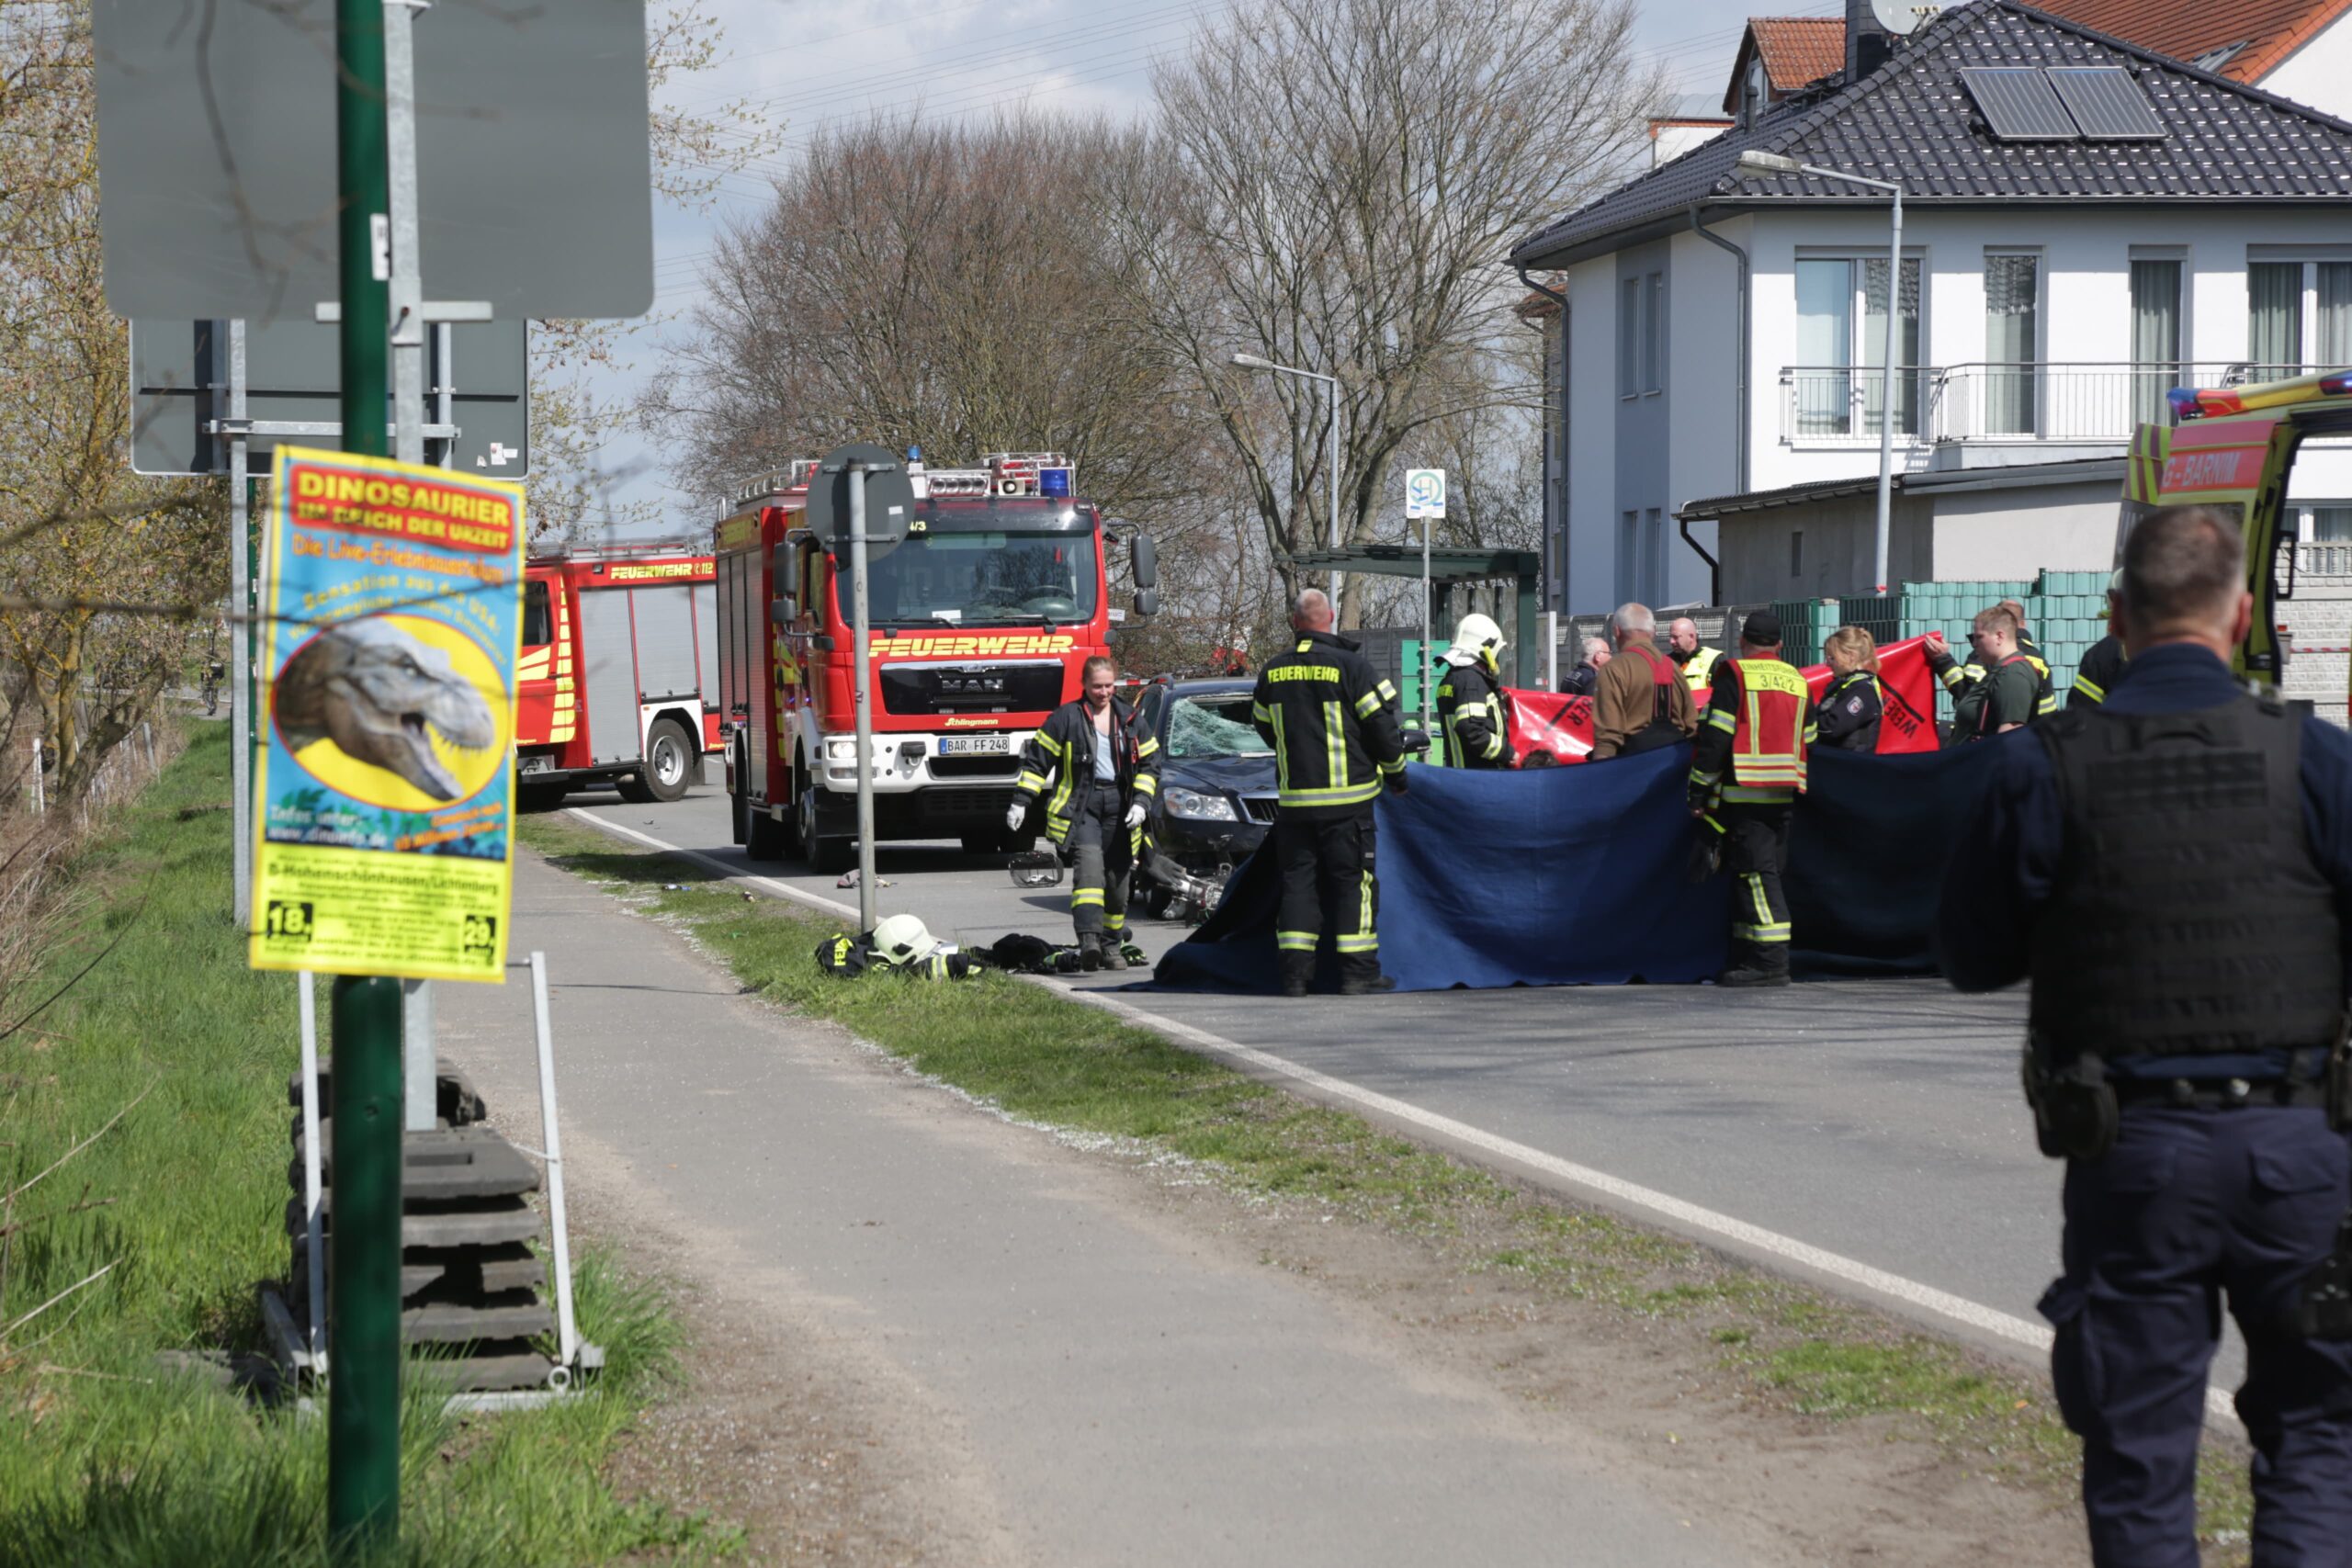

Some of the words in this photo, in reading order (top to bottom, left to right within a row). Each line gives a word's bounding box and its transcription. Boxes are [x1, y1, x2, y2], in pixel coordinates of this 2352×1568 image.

[299, 471, 510, 527] DINOSAURIER
[333, 506, 402, 531] REICH
[407, 515, 447, 537] DER
[449, 522, 509, 549] URZEIT
[292, 532, 322, 558] Die
[610, 563, 693, 580] FEUERWEHR
[701, 562, 714, 575] 112
[405, 576, 434, 592] aus
[868, 636, 1074, 658] FEUERWEHR
[1268, 665, 1340, 684] FEUERWEHR
[942, 679, 1004, 692] MAN
[944, 717, 1000, 728] Schlingmann
[947, 739, 967, 751] BAR
[974, 739, 987, 751] FF
[989, 739, 1008, 751] 248
